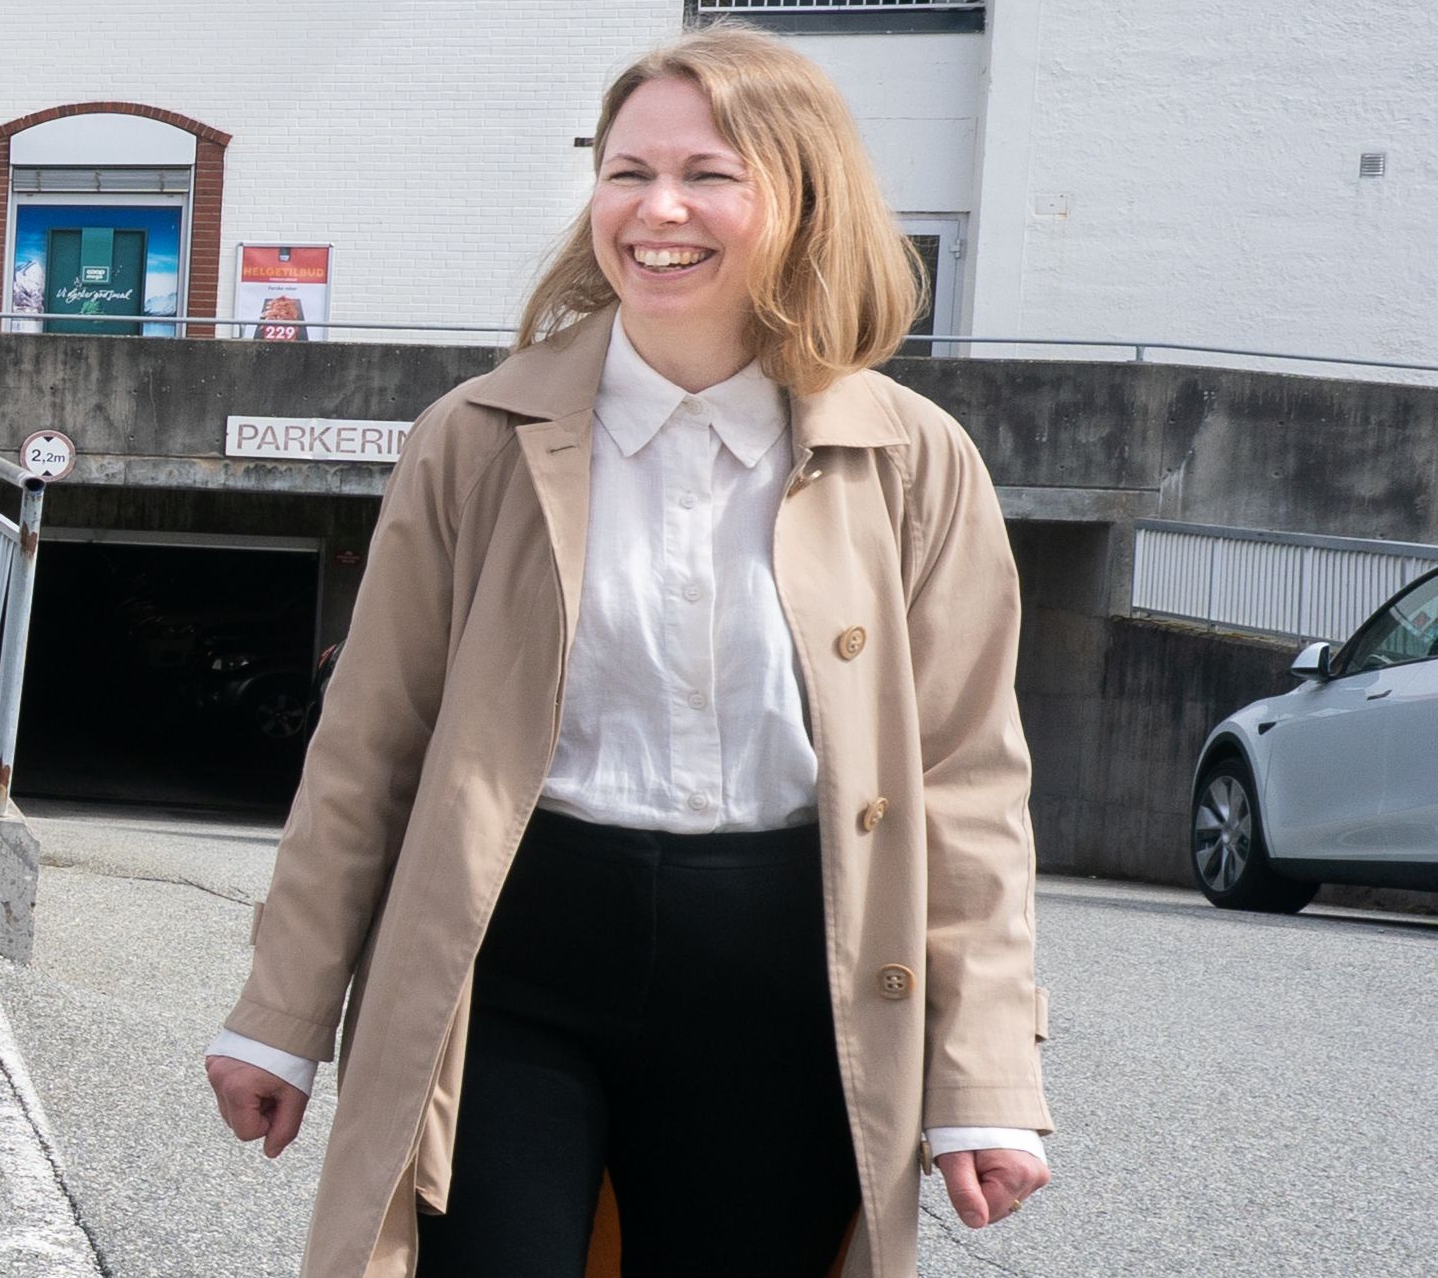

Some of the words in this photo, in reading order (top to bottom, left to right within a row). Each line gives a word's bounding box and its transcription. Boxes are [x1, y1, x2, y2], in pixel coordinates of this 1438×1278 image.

[243, 266, 325, 277] HELGETILBUD
[265, 326, 296, 340] 229
[31, 449, 66, 464] 2,2m
